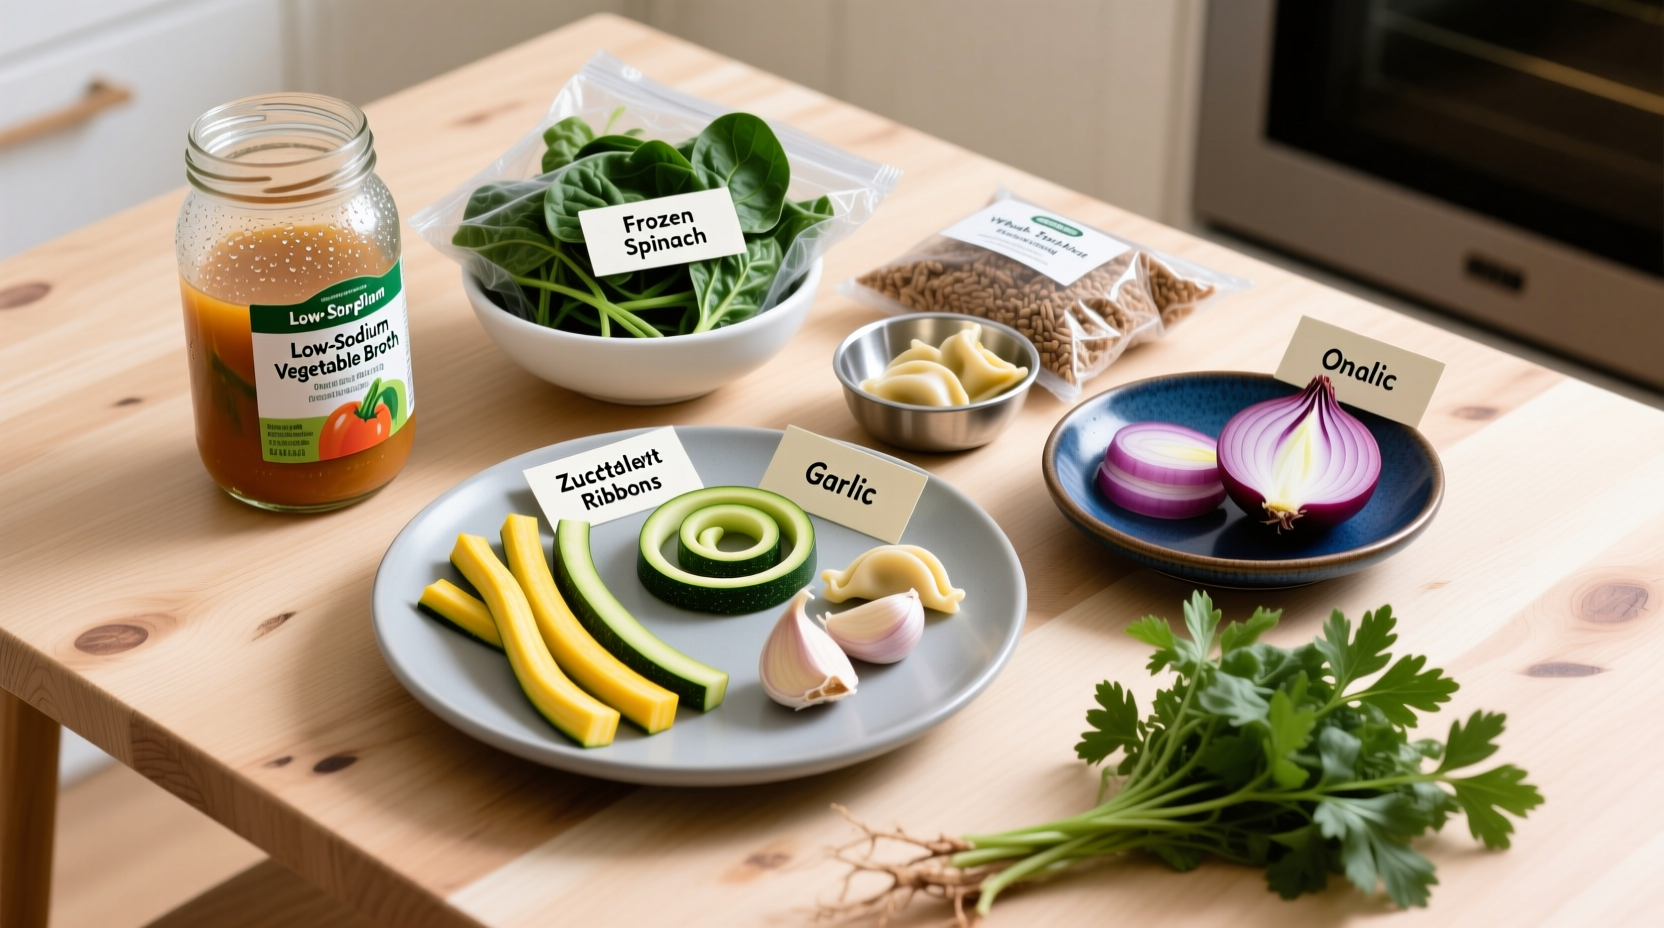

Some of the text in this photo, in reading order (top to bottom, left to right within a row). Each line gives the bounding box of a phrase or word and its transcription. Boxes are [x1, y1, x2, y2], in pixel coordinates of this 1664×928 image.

[623, 211, 694, 233] Frozen
[624, 227, 707, 260] Spinach
[274, 352, 361, 383] Vegetable
[364, 331, 399, 362] Broth
[291, 319, 389, 359] Low-Sodium
[1322, 348, 1397, 391] Onalic
[581, 476, 662, 511] Ribbons
[805, 462, 877, 505] Garlic
